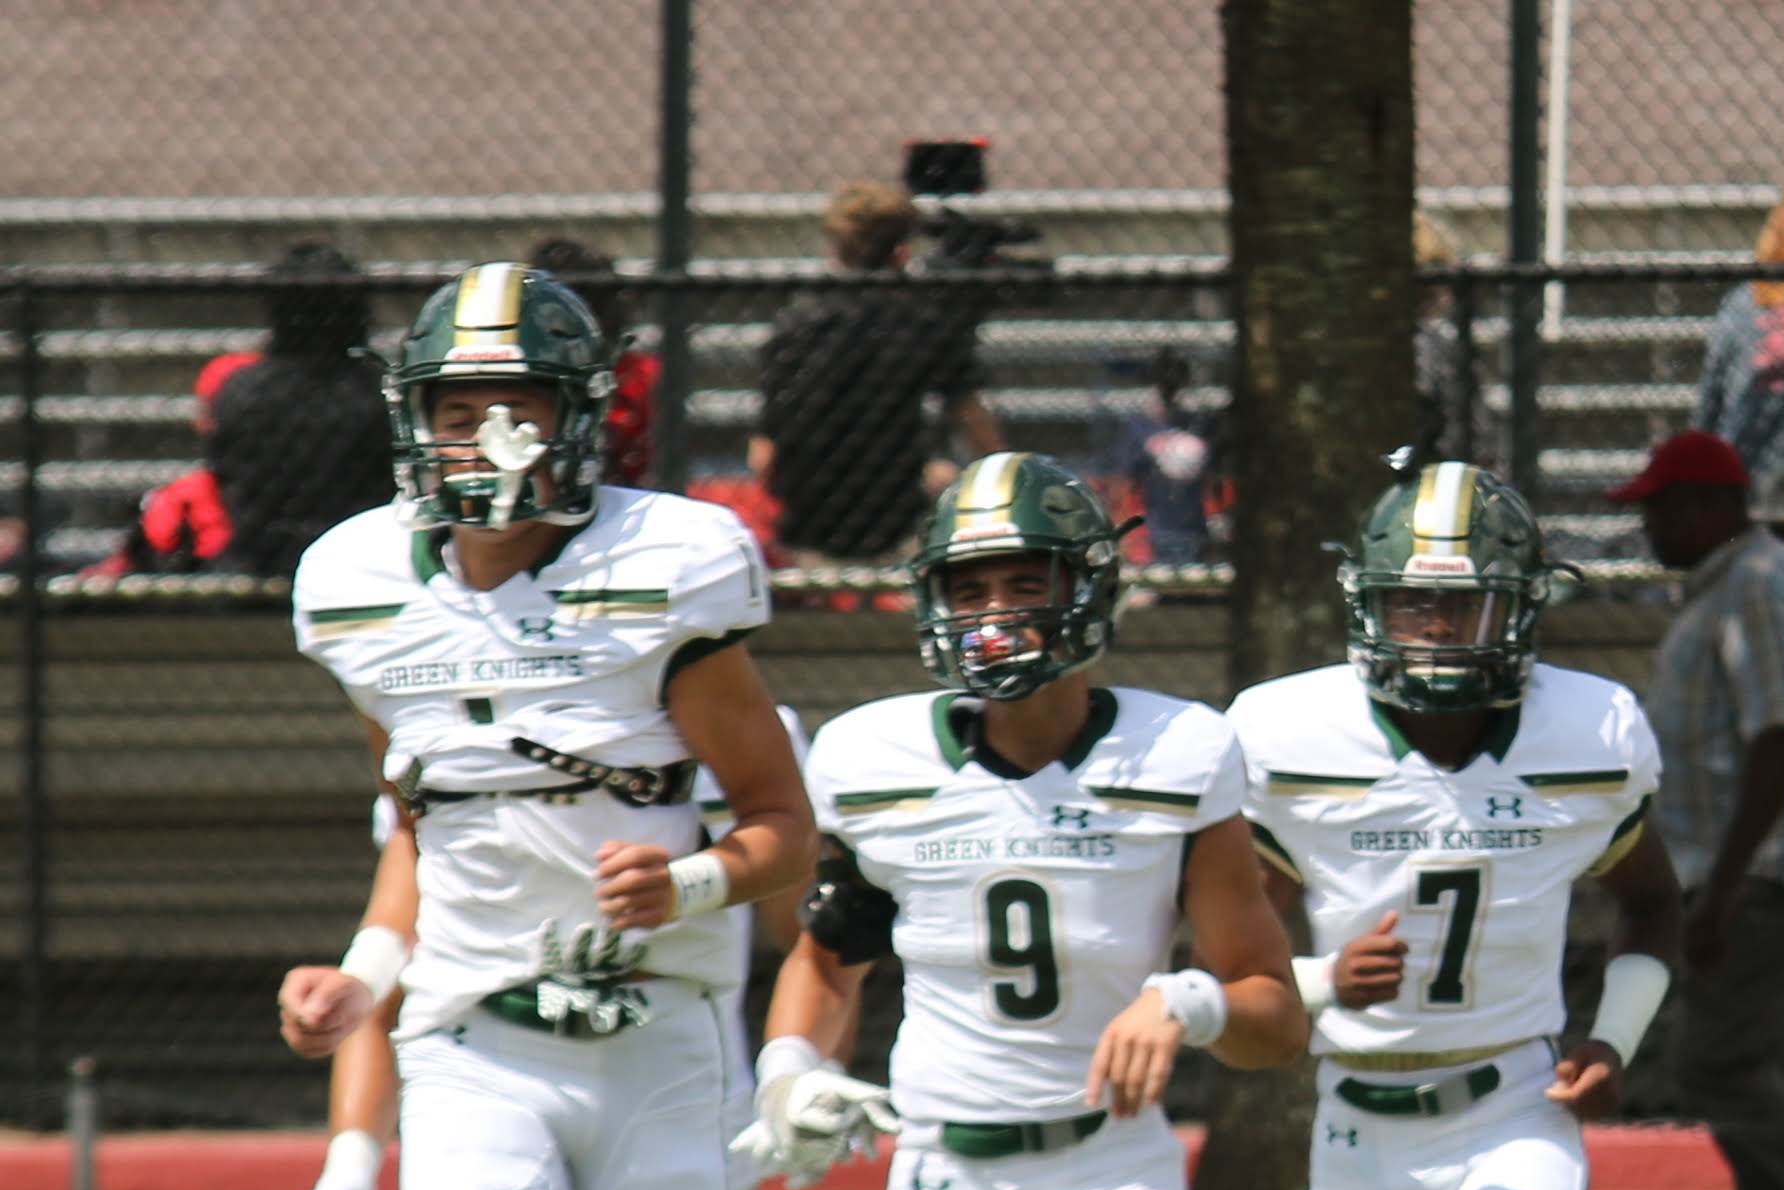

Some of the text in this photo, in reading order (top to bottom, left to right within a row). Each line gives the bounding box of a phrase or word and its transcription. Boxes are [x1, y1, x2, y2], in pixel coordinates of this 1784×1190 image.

[381, 655, 584, 690] GREEN KNIGHTS
[914, 834, 1115, 862] GREEN KNIGHTS
[1352, 829, 1543, 851] GREEN KNIGHTS
[984, 876, 1062, 1023] 9
[1414, 867, 1481, 1004] 7
